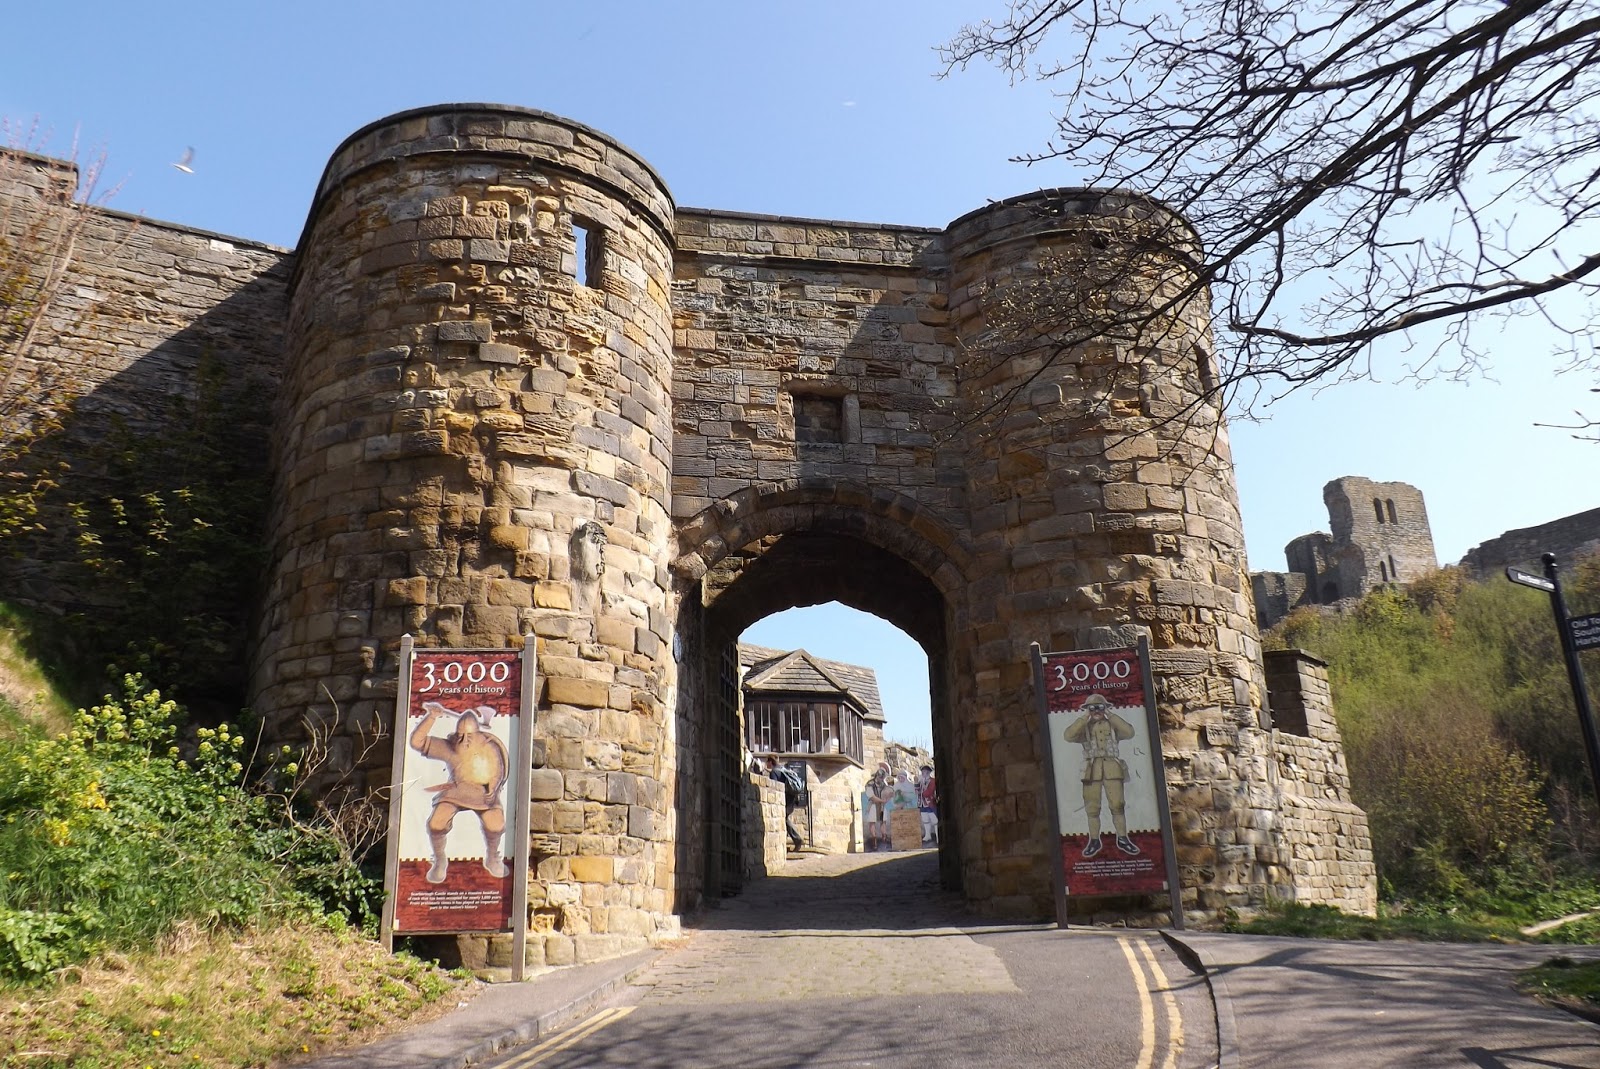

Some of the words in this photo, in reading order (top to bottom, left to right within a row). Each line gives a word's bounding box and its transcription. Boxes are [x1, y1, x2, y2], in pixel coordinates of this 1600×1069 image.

[1571, 620, 1588, 628] Old
[419, 661, 509, 692] 3,000
[1054, 660, 1130, 691] 3,000
[438, 686, 461, 696] years
[463, 684, 473, 693] of
[475, 685, 505, 695] history
[1071, 685, 1091, 693] years
[1092, 681, 1101, 690] of
[1102, 681, 1130, 690] history
